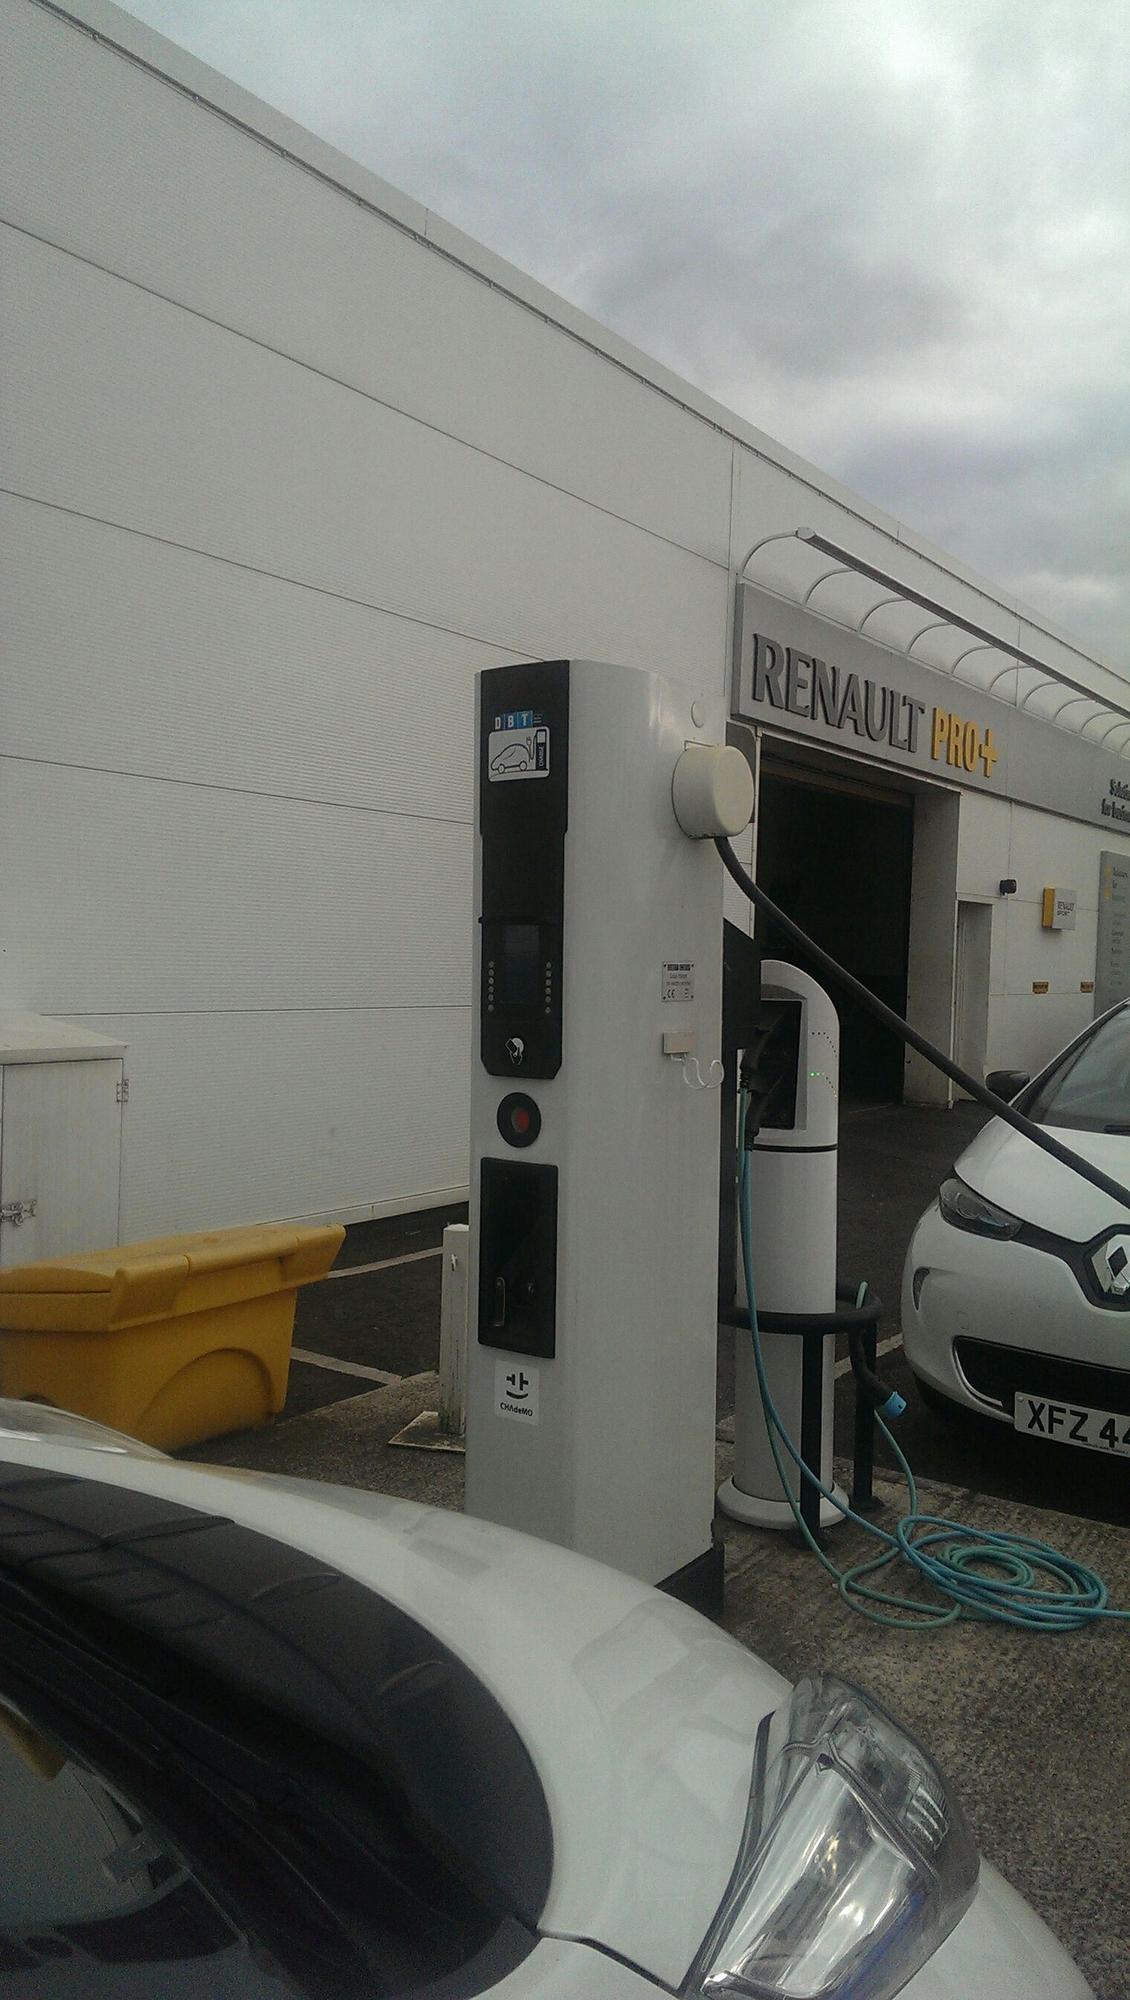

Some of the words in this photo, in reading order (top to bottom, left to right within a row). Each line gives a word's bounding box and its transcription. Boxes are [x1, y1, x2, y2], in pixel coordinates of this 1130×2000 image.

[752, 633, 926, 753] RENAULT
[931, 707, 998, 778] PRO+
[494, 713, 529, 730] DBT
[500, 1402, 533, 1416] CHAdeMO
[1028, 1400, 1088, 1442] XFZ
